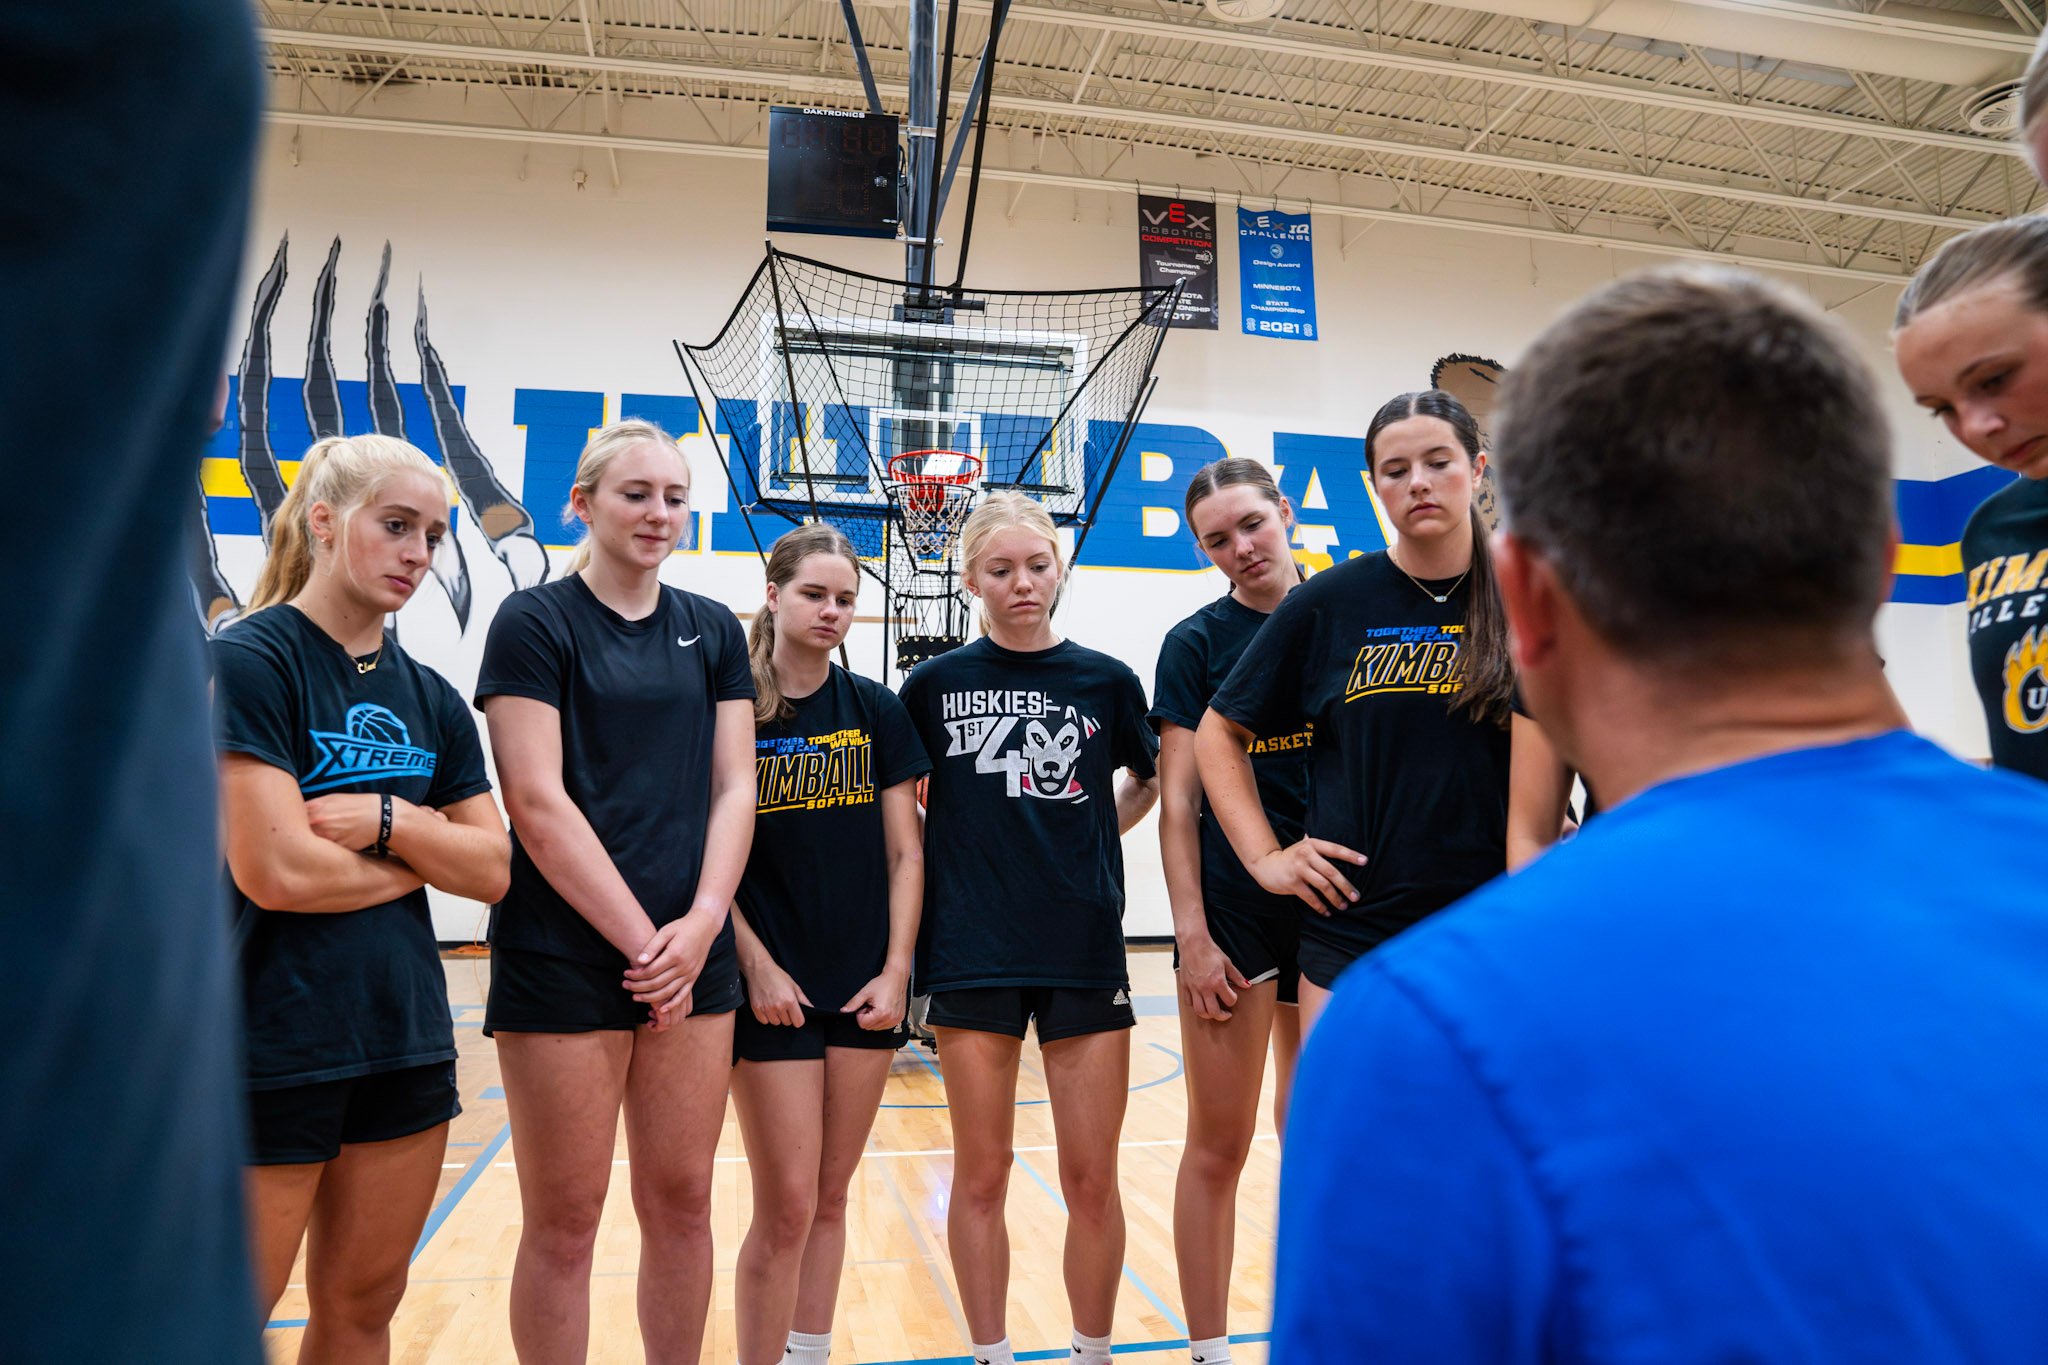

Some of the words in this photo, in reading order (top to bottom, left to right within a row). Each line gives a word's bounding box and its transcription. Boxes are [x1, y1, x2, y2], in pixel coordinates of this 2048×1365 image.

[803, 109, 865, 118] DAKTRONICS
[1142, 203, 1210, 230] VEX
[1241, 215, 1285, 231] VEX
[1288, 223, 1309, 234] IQ
[1141, 225, 1212, 239] ROBOTICS
[1240, 228, 1310, 241] CHALLENGE
[1141, 234, 1212, 248] COMPETITION
[1155, 260, 1200, 269] Tournament
[1253, 259, 1275, 268] Design
[1159, 267, 1196, 275] Champion
[1253, 283, 1301, 291] MINNESOTA
[1250, 304, 1305, 313] CHAMPIONSHIP
[1260, 321, 1299, 333] 2021
[1366, 625, 1438, 638] TOGETHER
[1400, 633, 1422, 642] WE
[1424, 632, 1453, 641] CAN
[942, 689, 1042, 720] HUSKIES
[807, 728, 861, 746] TOGETHER
[830, 737, 849, 750] WE
[849, 733, 872, 747] WILL
[956, 720, 984, 751] 1ST
[755, 736, 806, 749] OGETHER
[777, 746, 794, 754] WE
[796, 744, 819, 753] CAN
[320, 738, 437, 776] XTREME
[806, 792, 874, 810] SOFTBALL
